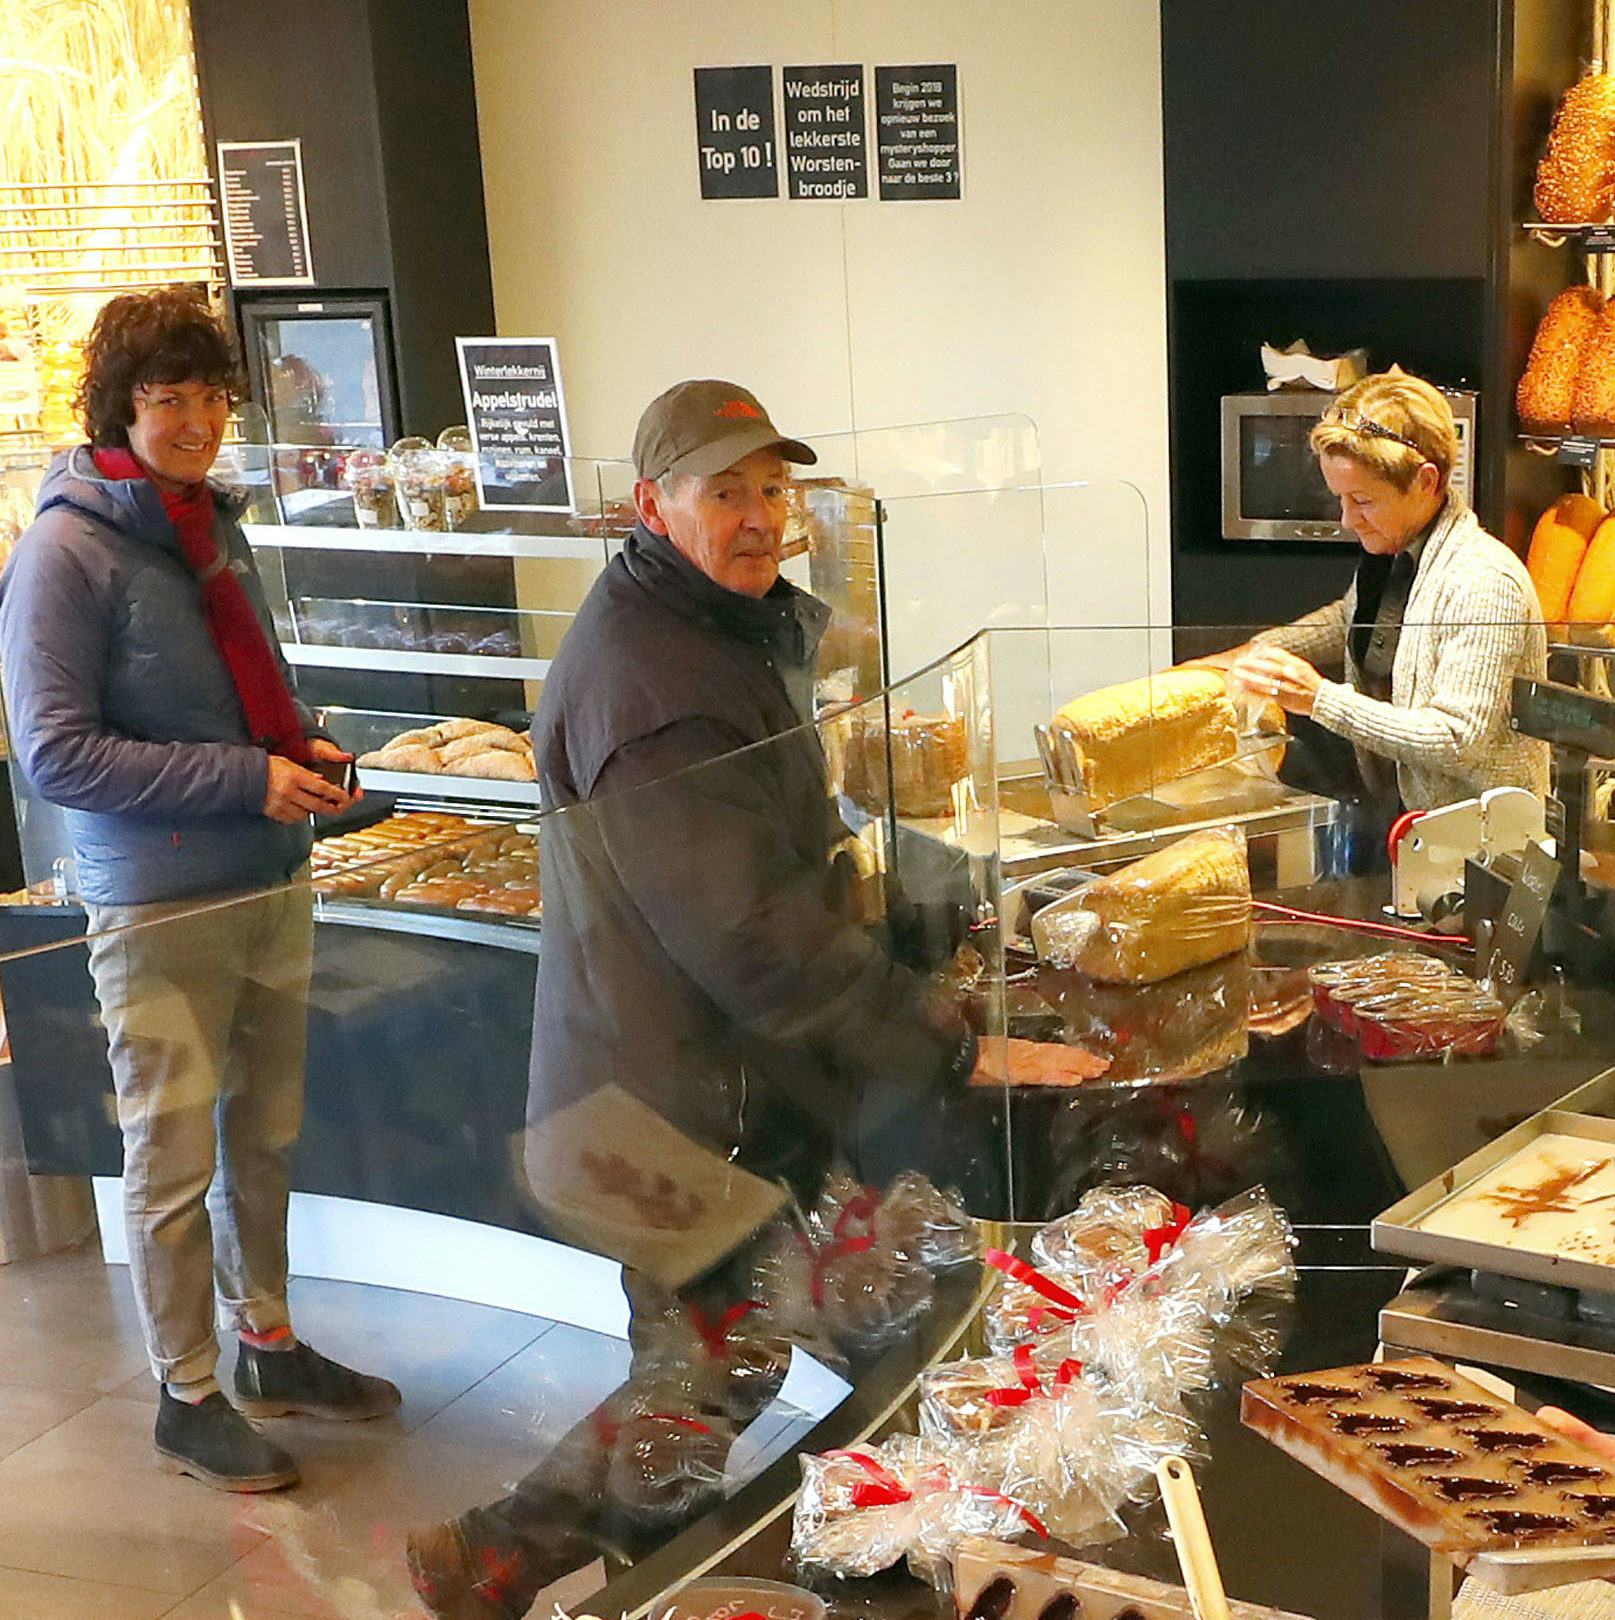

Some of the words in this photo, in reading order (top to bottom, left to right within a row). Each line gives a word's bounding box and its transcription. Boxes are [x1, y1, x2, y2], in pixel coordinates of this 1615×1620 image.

[786, 80, 859, 100] Wedstrijd
[893, 98, 926, 111] krijgen
[927, 99, 942, 108] we
[711, 109, 730, 131] In
[736, 108, 760, 130] de
[798, 109, 822, 122] om
[826, 105, 850, 122] het
[881, 113, 921, 127] opnieuw
[922, 112, 955, 123] bezoek
[789, 131, 861, 147] lekkerste
[900, 130, 917, 139] van
[918, 129, 937, 138] een
[701, 146, 736, 174] Top
[740, 145, 760, 168] 10
[790, 155, 861, 172] Worsten-
[888, 158, 912, 169] Gaan
[913, 159, 928, 168] we
[929, 157, 952, 168] door
[881, 175, 903, 183] naar
[904, 172, 916, 183] de
[917, 172, 944, 183] beste
[945, 171, 952, 182] 3
[799, 179, 856, 198] broodje
[473, 391, 558, 411] Appelstrudel
